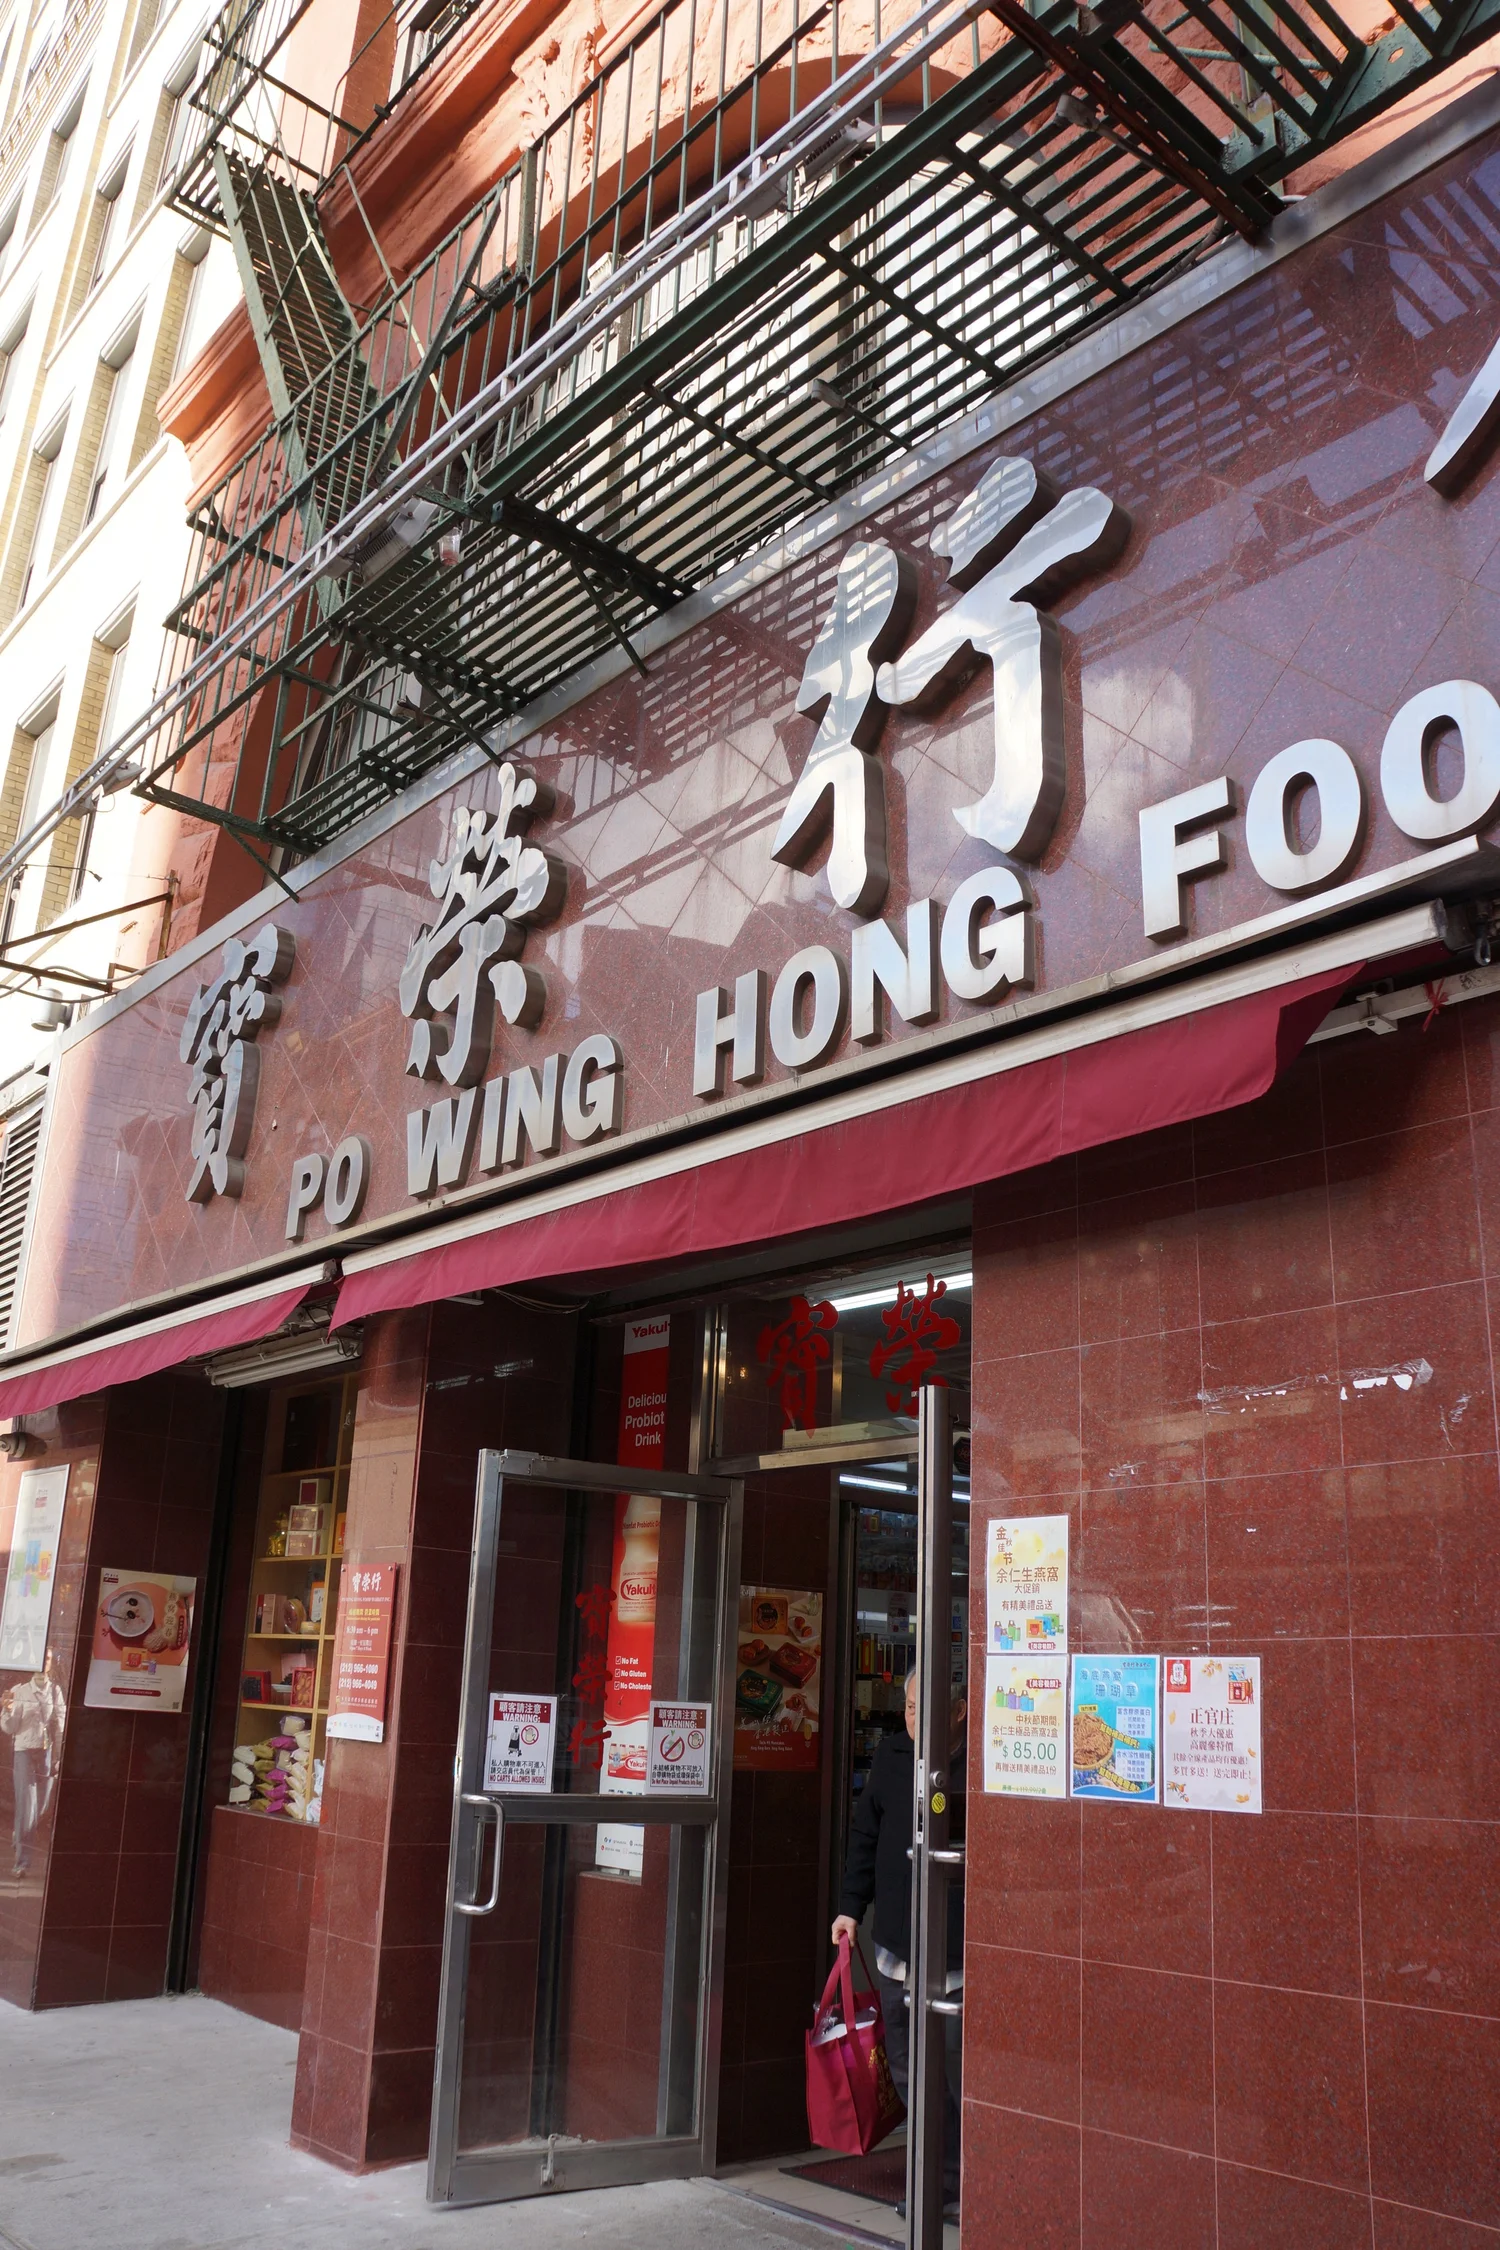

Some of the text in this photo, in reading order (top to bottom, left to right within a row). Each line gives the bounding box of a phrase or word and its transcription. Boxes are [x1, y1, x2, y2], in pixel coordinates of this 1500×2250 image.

[286, 1135, 371, 1241] PO
[406, 1033, 625, 1198] WING
[693, 866, 1036, 1097] HONG
[635, 1431, 661, 1447] Drink
[352, 1572, 382, 1593] 寶榮行
[626, 1584, 657, 1596] Yakult
[340, 1662, 353, 1674] (212)
[629, 1670, 647, 1678] Gluten
[338, 1677, 352, 1689] (212)
[502, 1713, 541, 1723] WARNING:
[1189, 1707, 1234, 1725] 正官庄
[662, 1719, 697, 1728] WARNING:
[1002, 1741, 1057, 1761] $ 85.00
[497, 1774, 511, 1782] CARTS
[511, 1775, 530, 1783] ALLOWED
